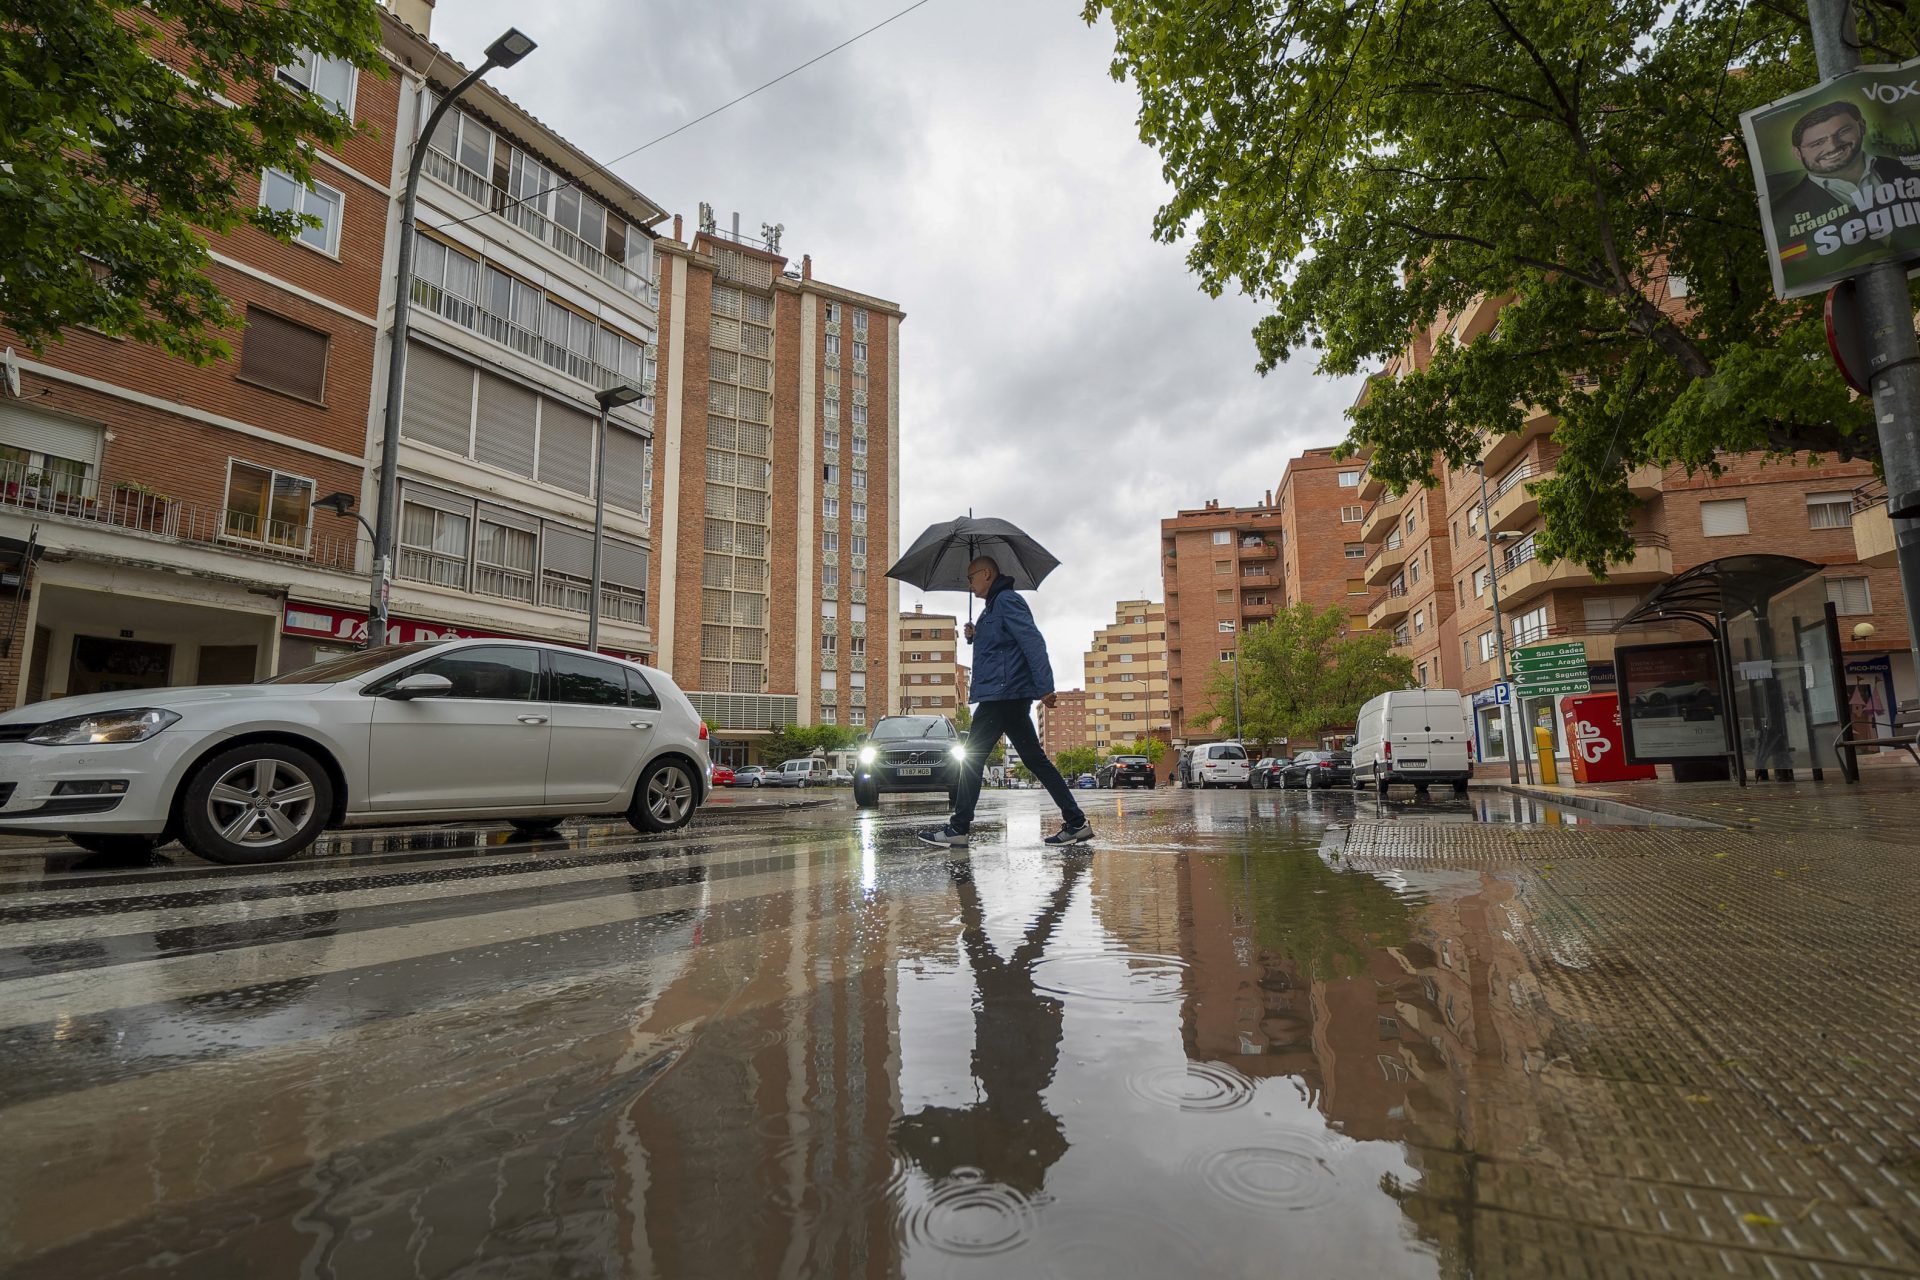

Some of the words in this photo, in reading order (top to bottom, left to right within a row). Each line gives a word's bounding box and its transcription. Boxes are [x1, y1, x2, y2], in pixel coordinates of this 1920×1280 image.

[1862, 80, 1920, 104] VOX
[1789, 204, 1850, 238] Aragón
[1795, 211, 1811, 224] En
[1559, 647, 1584, 655] Gadea
[1558, 657, 1585, 666] Aragón
[1555, 671, 1588, 679] Sagunto
[1496, 685, 1507, 703] P
[1538, 686, 1560, 694] Playa
